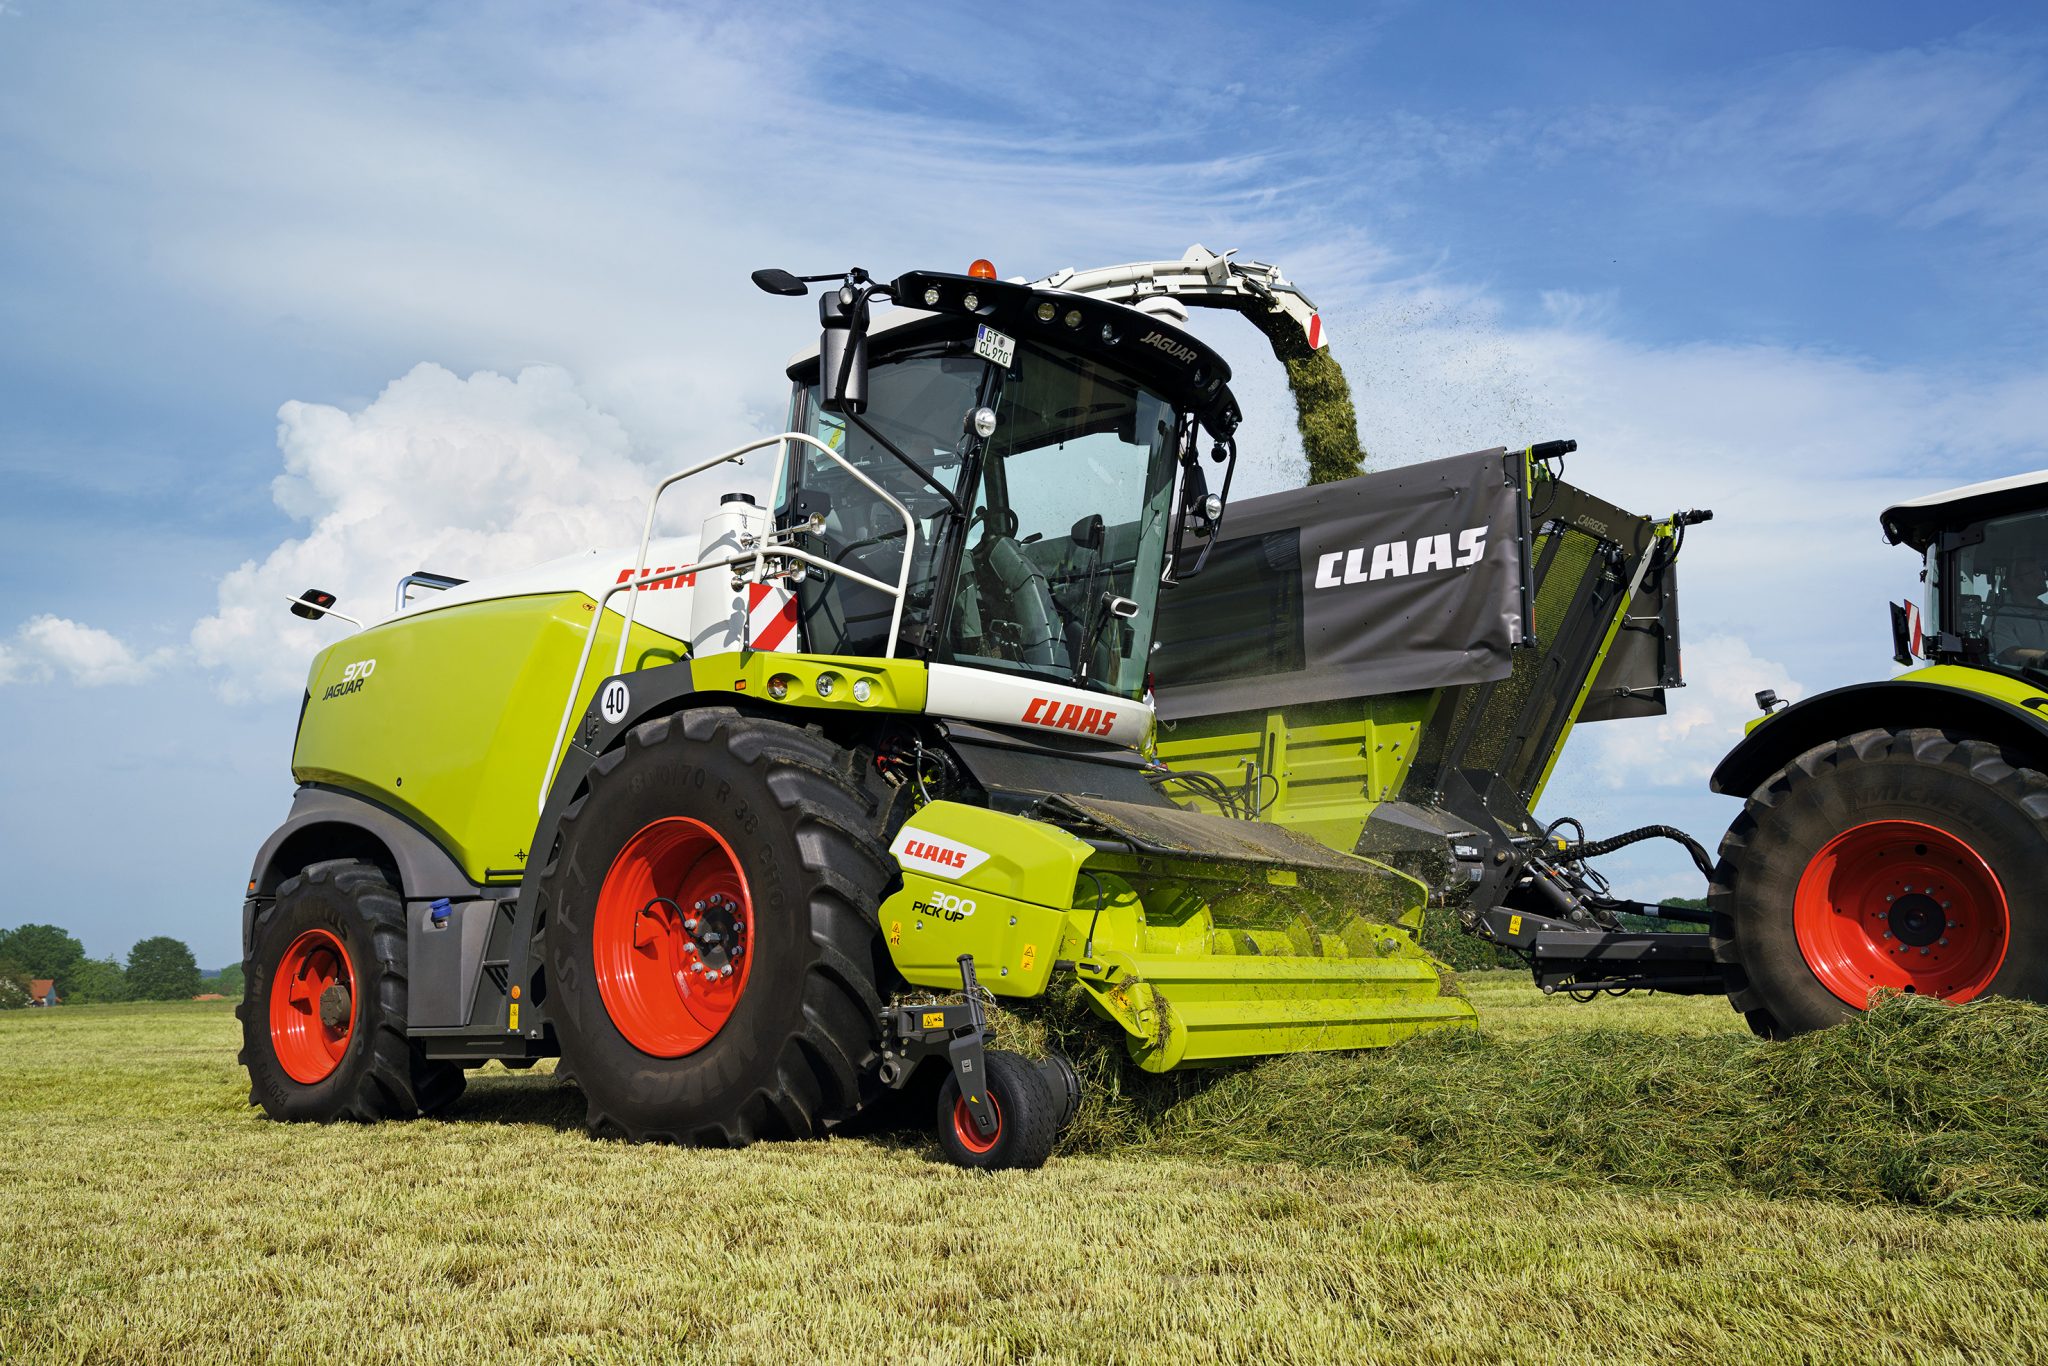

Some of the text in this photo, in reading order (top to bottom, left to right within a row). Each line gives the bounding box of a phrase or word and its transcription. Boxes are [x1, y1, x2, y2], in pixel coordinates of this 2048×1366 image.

[986, 330, 999, 345] GT
[1139, 330, 1198, 365] JAGUAR
[1577, 514, 1609, 534] CARGOS
[1314, 525, 1489, 590] CLAAS
[616, 563, 697, 592] CLAA
[342, 659, 377, 683] 970
[322, 678, 365, 701] JAGUAR
[606, 687, 625, 714] 40
[1021, 697, 1117, 737] CLAAS
[715, 777, 733, 805] R
[735, 799, 760, 835] 38
[904, 839, 968, 869] CLAAS
[912, 901, 965, 923] PICK UP
[929, 890, 977, 917] 300
